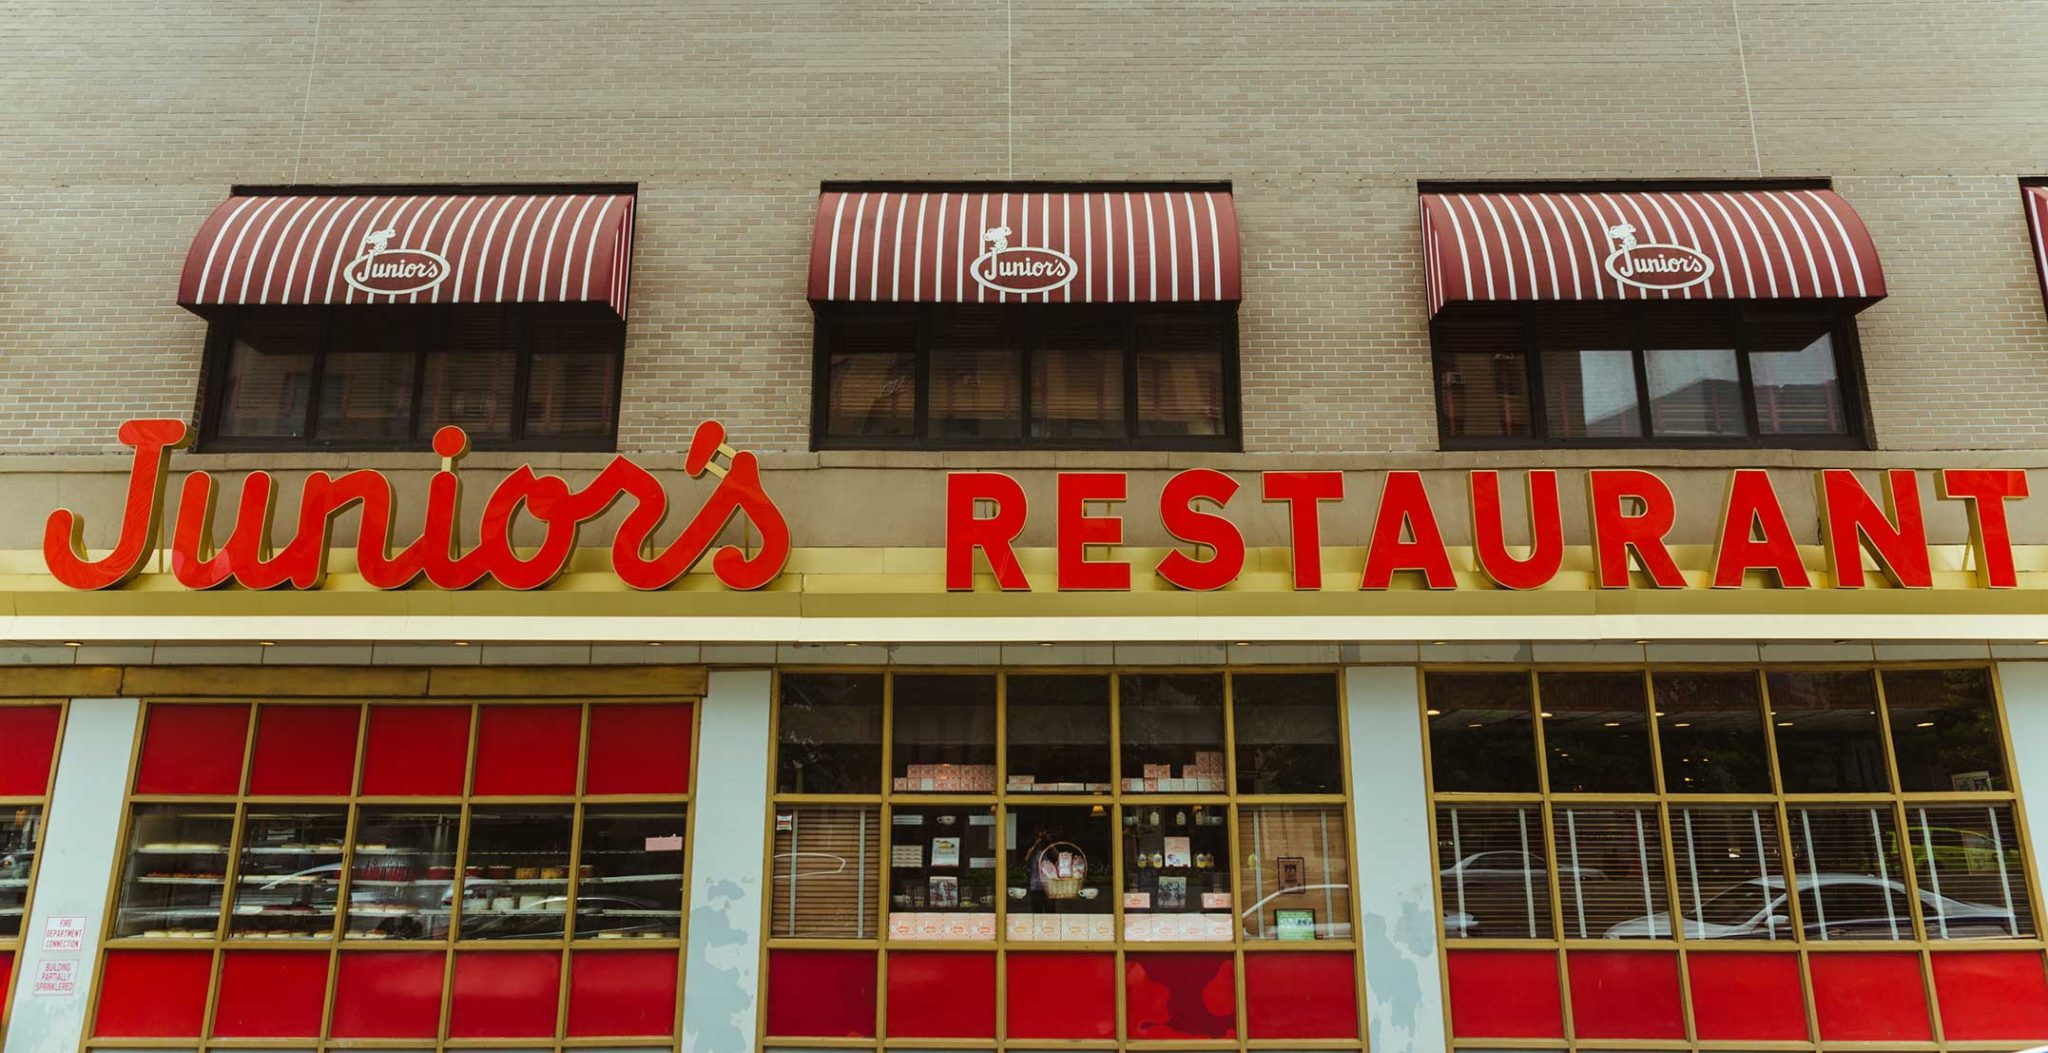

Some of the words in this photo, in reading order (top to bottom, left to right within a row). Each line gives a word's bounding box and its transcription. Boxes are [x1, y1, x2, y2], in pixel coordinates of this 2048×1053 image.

[983, 247, 1066, 280] Junior's
[1619, 244, 1702, 277] Junior's
[357, 249, 438, 282] Junior's
[43, 418, 792, 592] Junior's
[944, 466, 2030, 592] RESTAURANT
[60, 919, 73, 927] FIRE
[46, 929, 82, 938] DEPARTMENT
[45, 939, 79, 948] CONNECTION
[45, 962, 71, 972] BUILDING
[41, 972, 71, 981] PARTIALLY
[34, 982, 74, 991] SPRINKLERED
